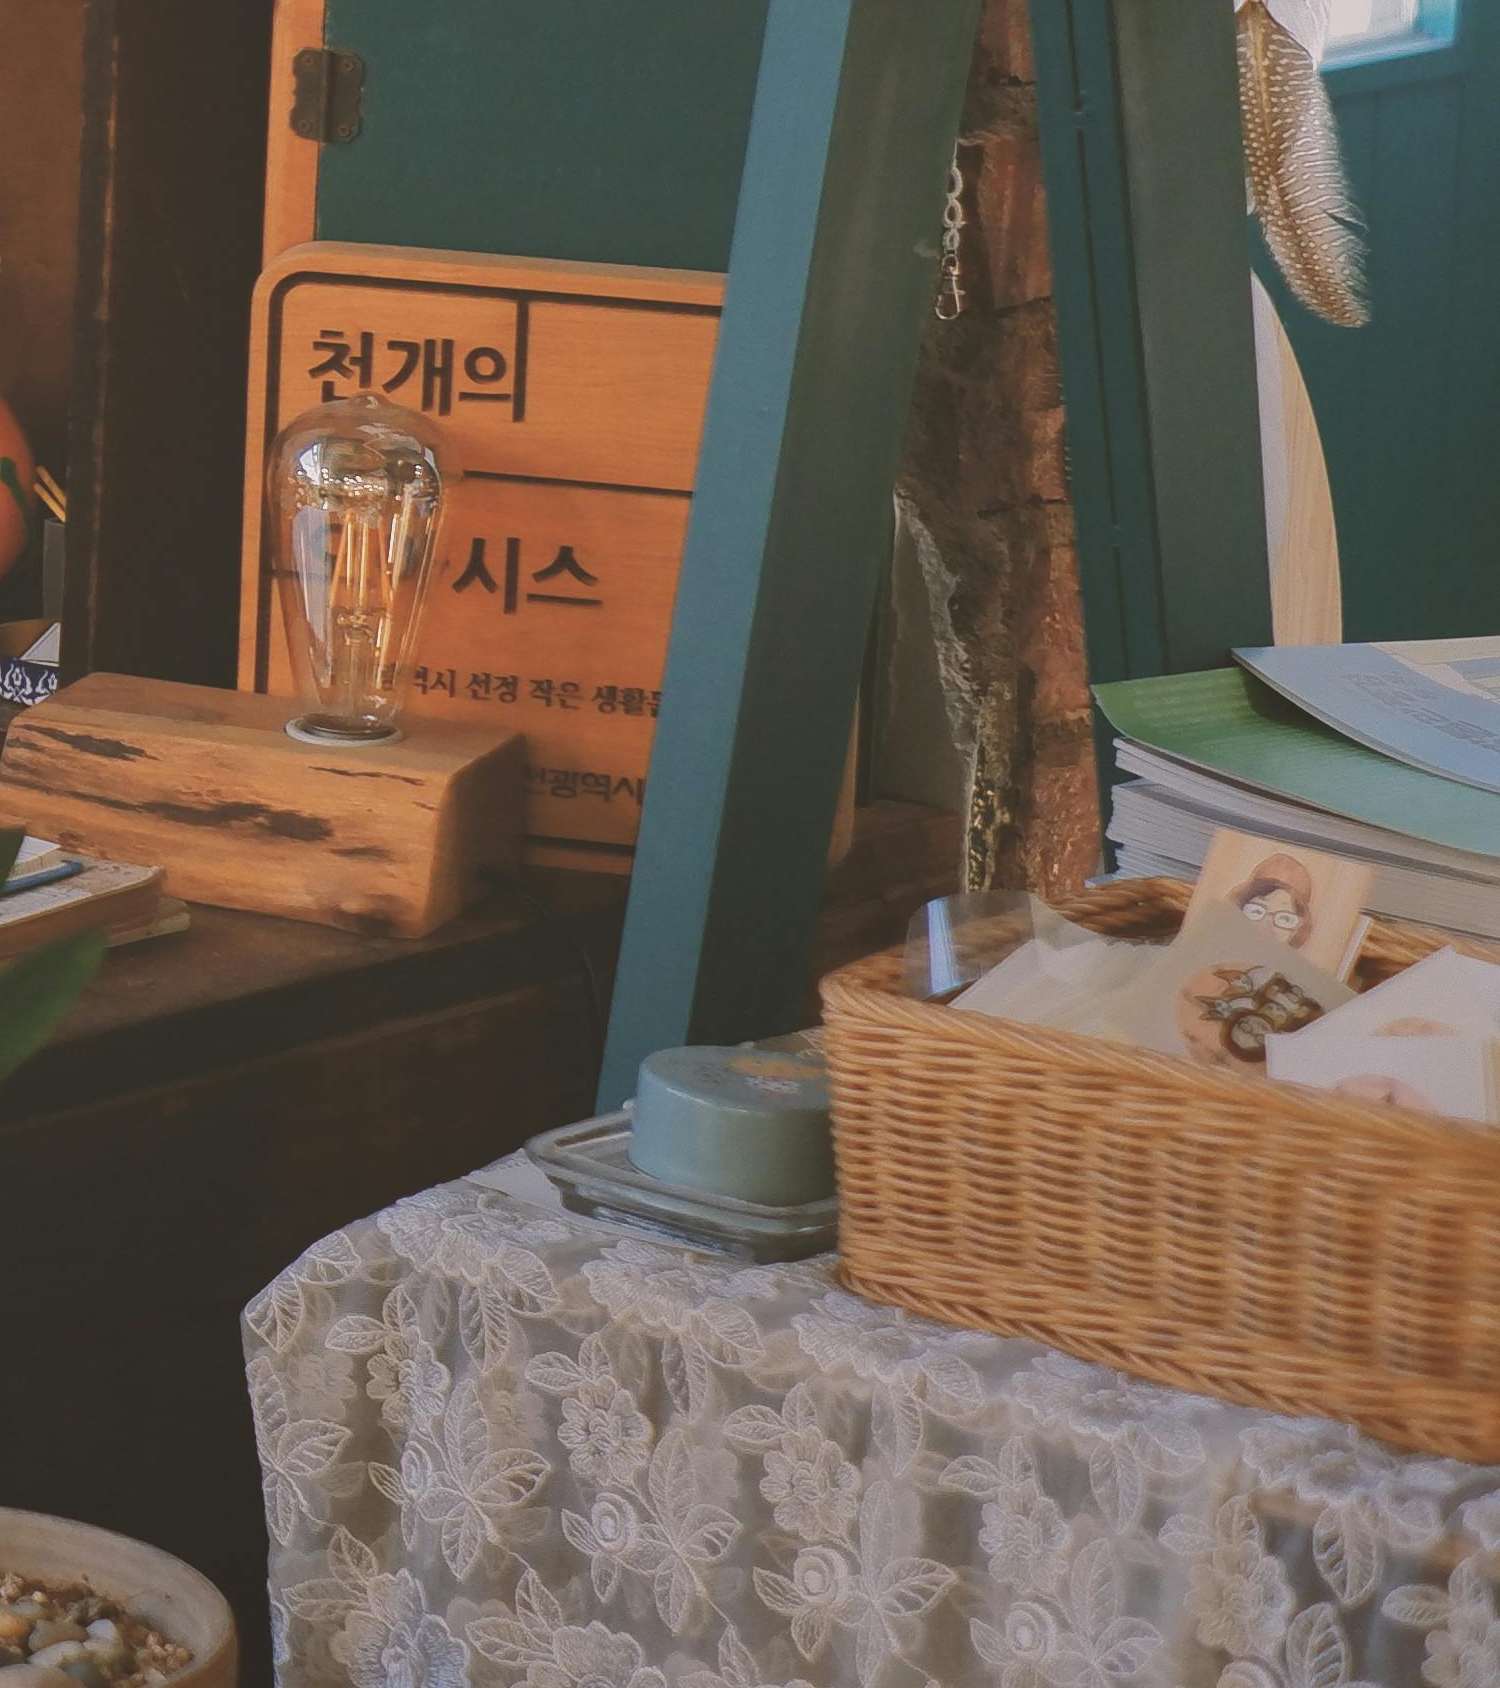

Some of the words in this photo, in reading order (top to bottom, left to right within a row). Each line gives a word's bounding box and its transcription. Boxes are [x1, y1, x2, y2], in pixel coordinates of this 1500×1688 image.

[308, 329, 525, 423] 천개의
[466, 672, 518, 704] 선정
[529, 679, 580, 709] 작은
